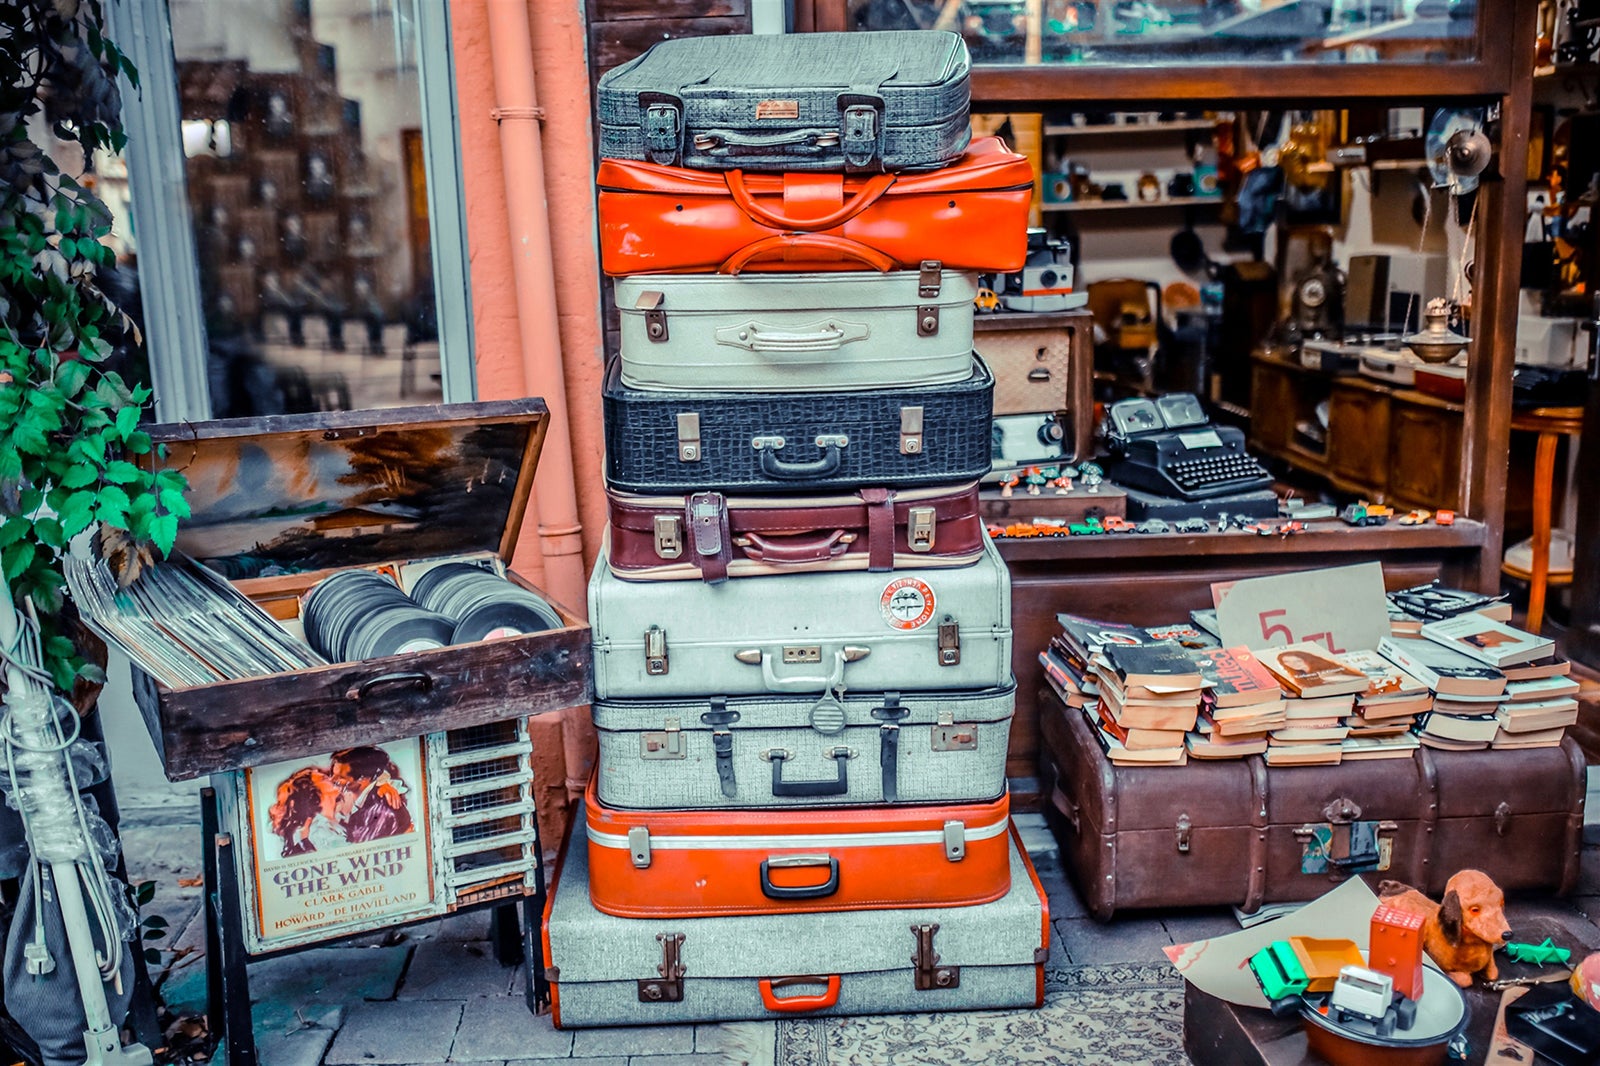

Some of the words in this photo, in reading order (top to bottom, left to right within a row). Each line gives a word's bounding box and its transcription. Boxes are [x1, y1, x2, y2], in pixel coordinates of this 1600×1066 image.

[273, 860, 340, 885] GONE
[348, 846, 411, 870] WITH
[280, 876, 330, 899] THE
[339, 862, 403, 886] WIND
[275, 911, 325, 929] HOWARD
[334, 907, 347, 916] DE
[351, 892, 417, 912] HAVILLAND
[304, 892, 345, 908] CLARK
[348, 883, 384, 898] GABLE
